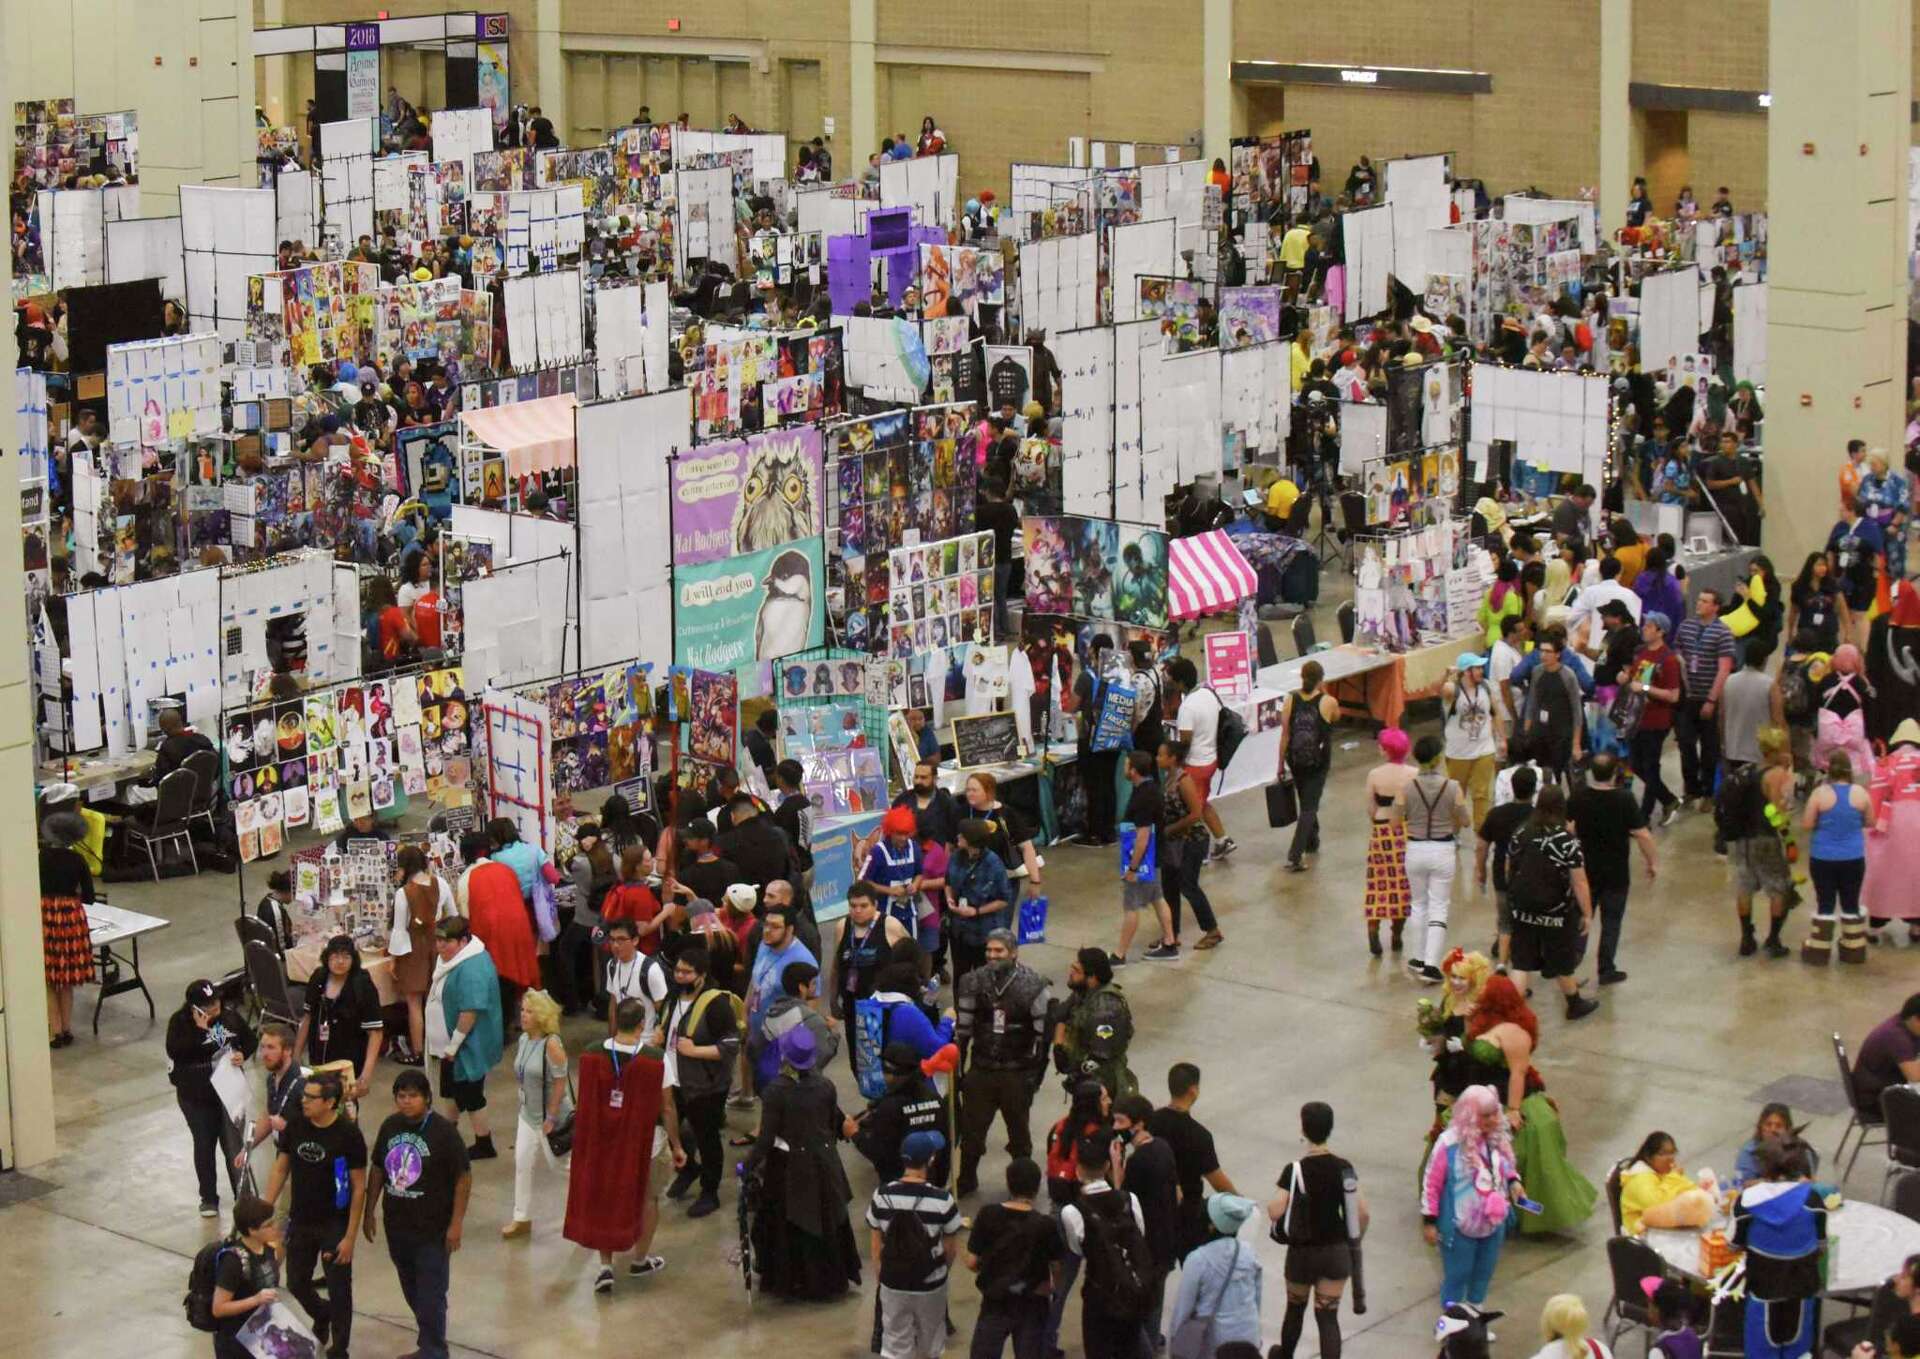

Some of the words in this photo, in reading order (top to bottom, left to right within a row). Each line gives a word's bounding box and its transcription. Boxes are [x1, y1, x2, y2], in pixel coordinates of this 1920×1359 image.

[349, 27, 376, 46] 2018
[692, 585, 713, 601] will
[715, 580, 733, 595] end
[735, 577, 753, 594] you
